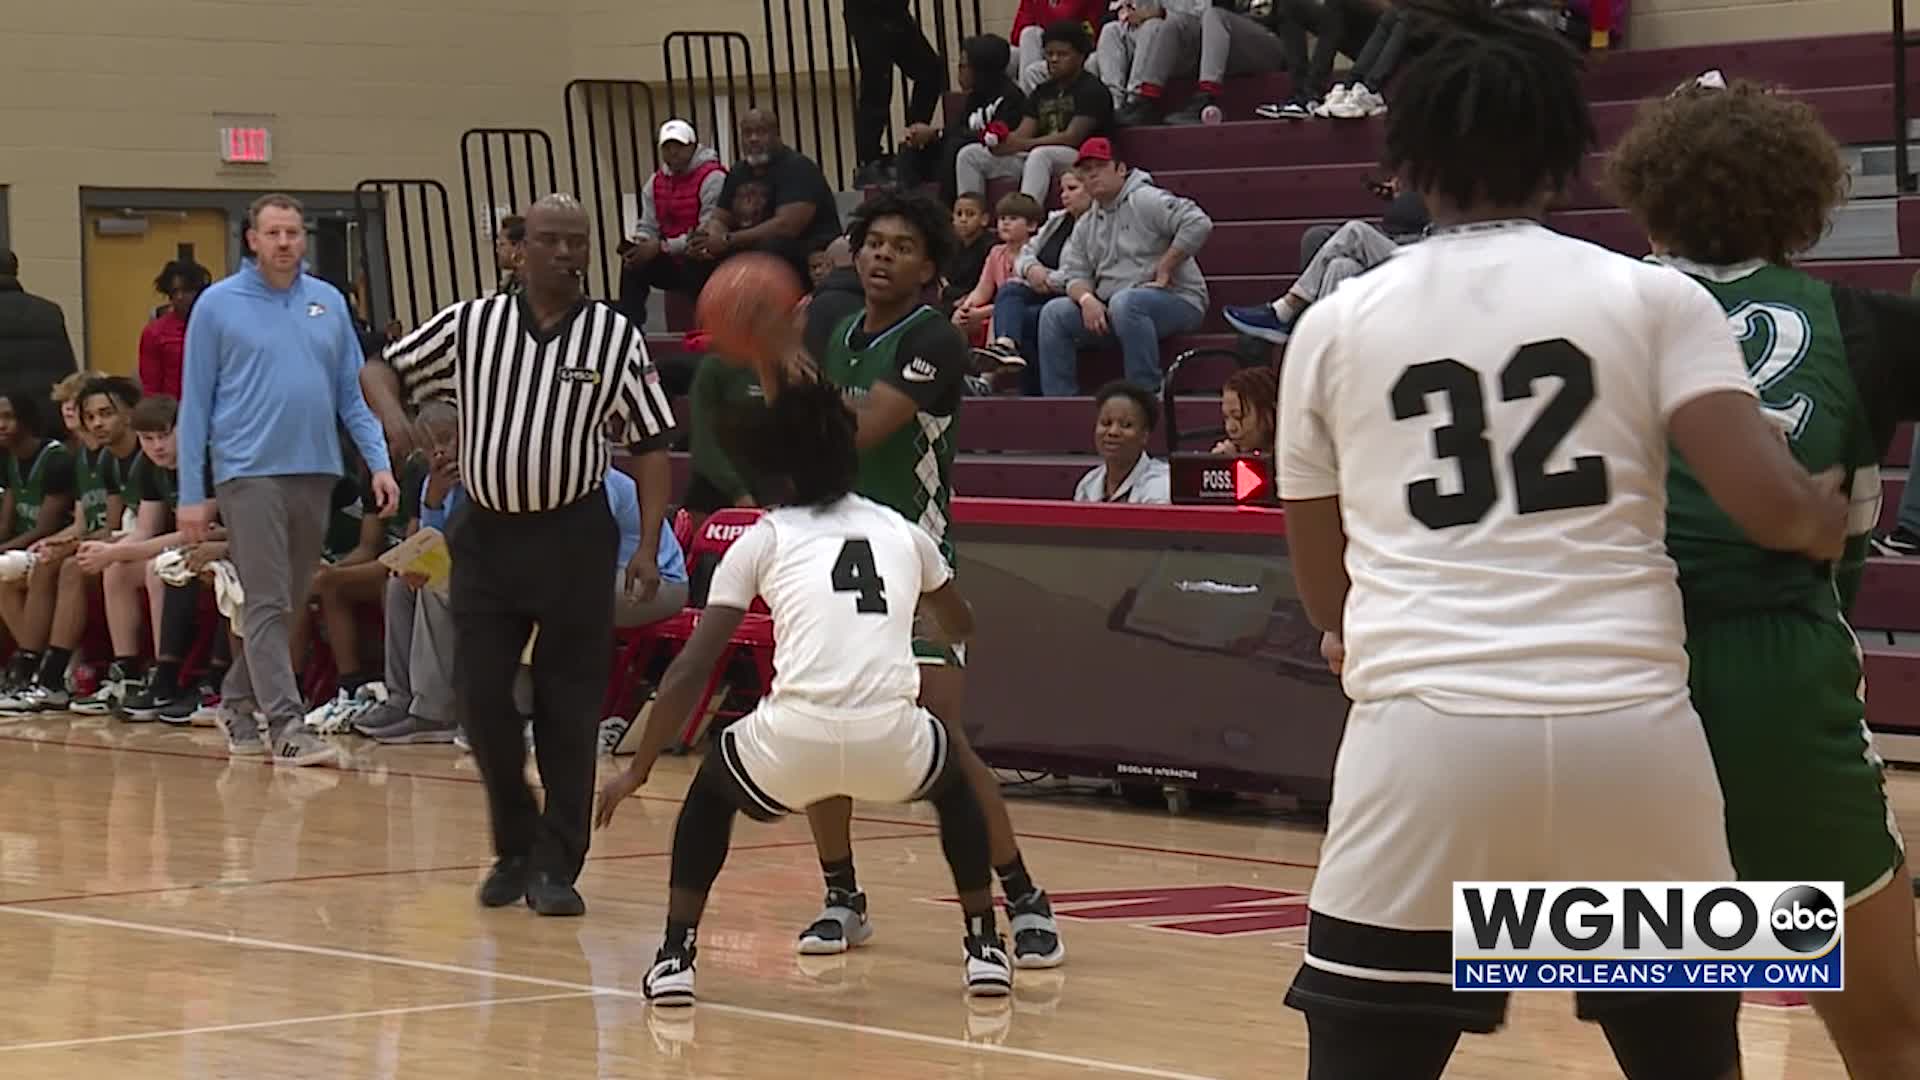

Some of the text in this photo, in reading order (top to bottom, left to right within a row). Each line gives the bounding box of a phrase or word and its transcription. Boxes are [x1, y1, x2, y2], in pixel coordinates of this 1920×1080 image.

[231, 128, 265, 160] EXIT
[1391, 337, 1608, 530] 32
[1203, 469, 1235, 489] POSS.
[831, 538, 889, 614] 4
